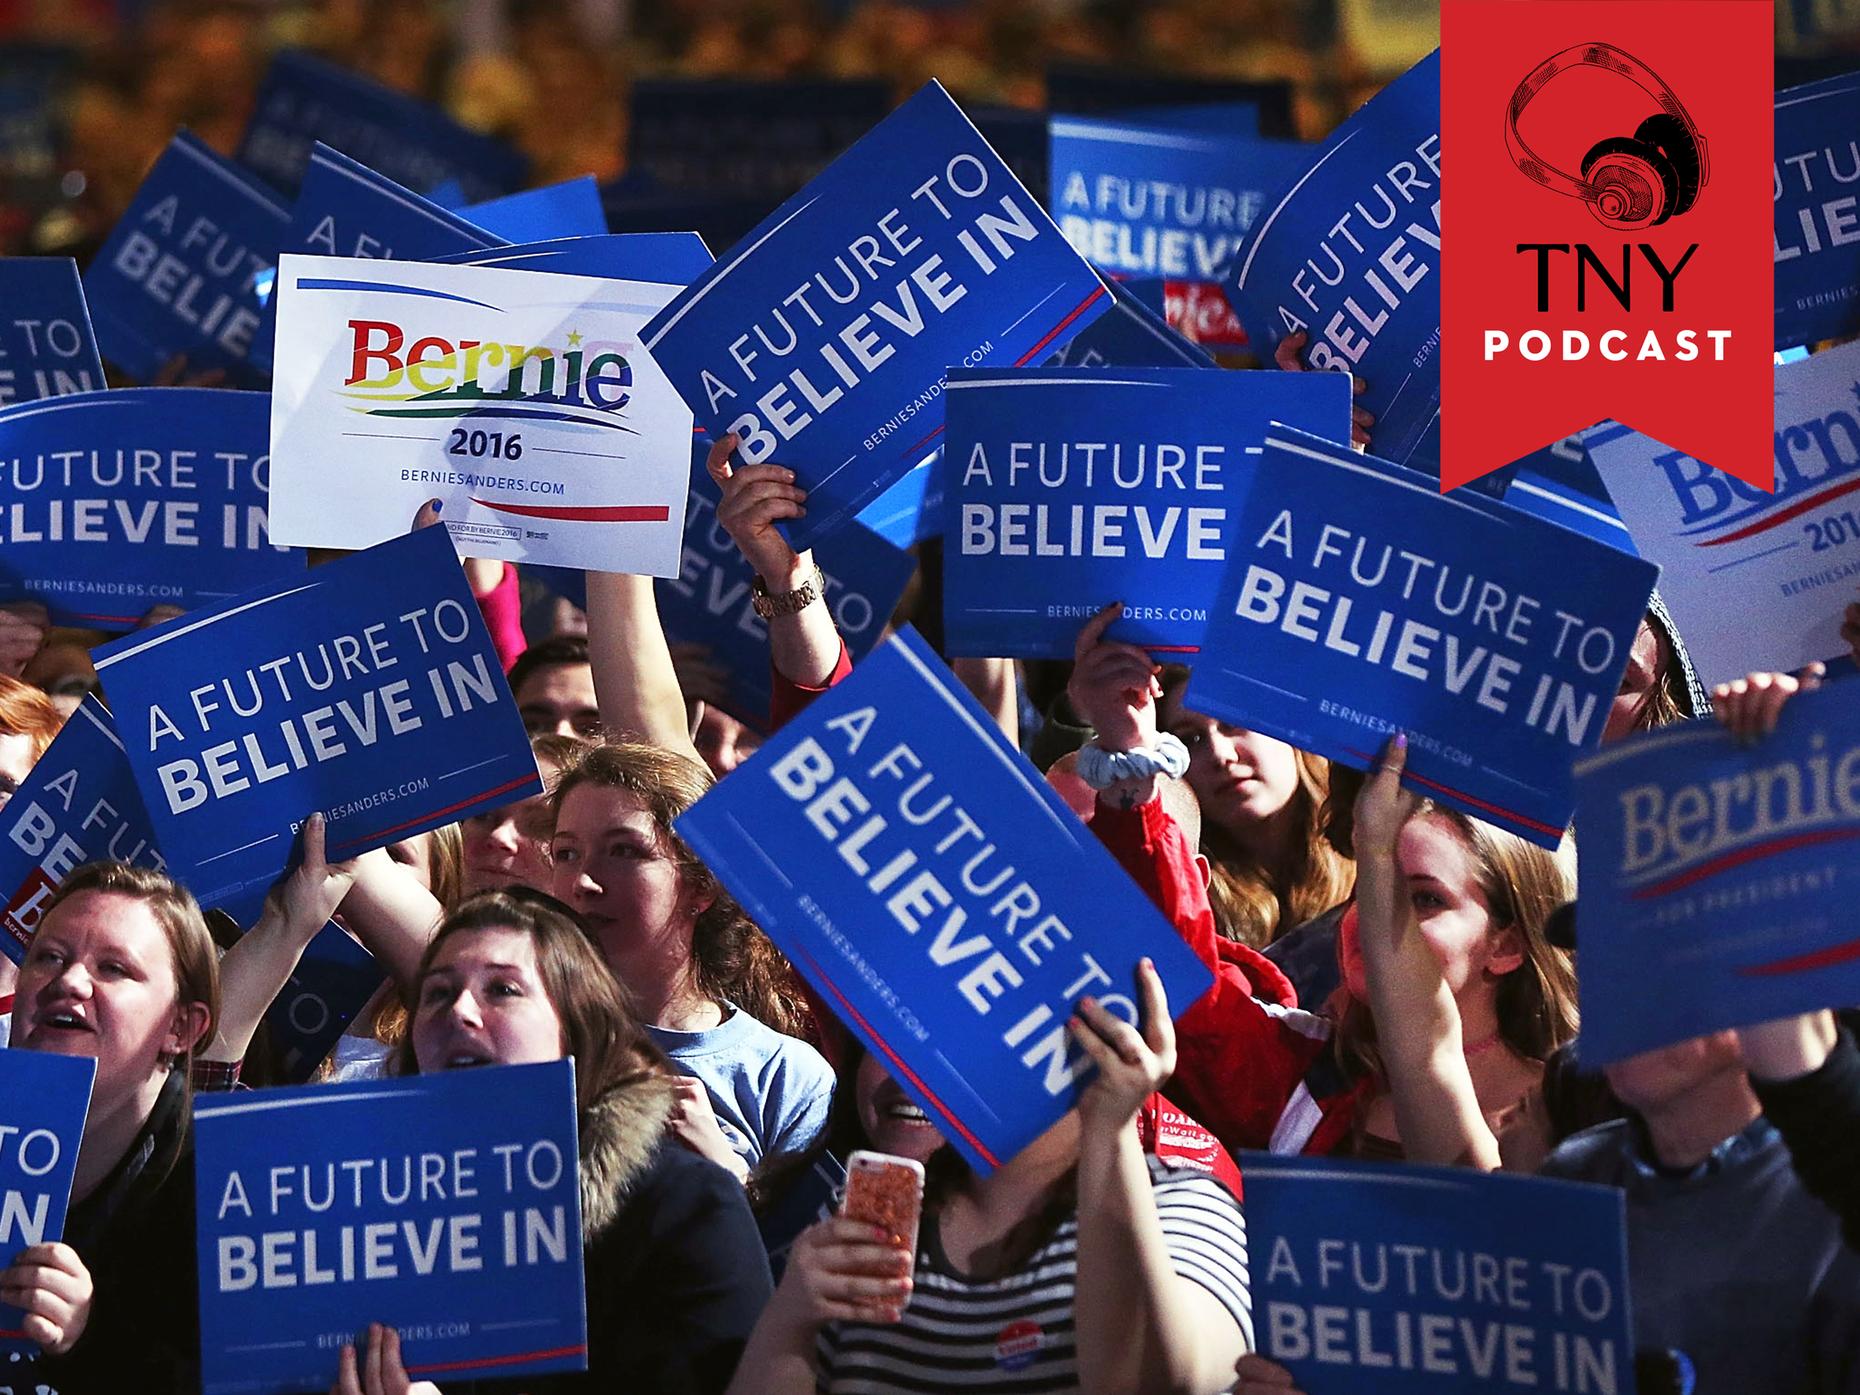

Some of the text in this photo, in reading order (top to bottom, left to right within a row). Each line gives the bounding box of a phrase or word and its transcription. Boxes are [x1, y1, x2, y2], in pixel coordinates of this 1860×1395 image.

[145, 195, 179, 236] A
[1062, 171, 1090, 212] A
[306, 214, 337, 250] A
[1059, 214, 1243, 281] BELIEV
[700, 153, 988, 415] A FUTURE TO
[13, 319, 82, 357] TO
[726, 195, 1040, 465] BELIEVE IN
[344, 319, 634, 411] Bernie
[864, 341, 994, 451] BERNIESANDECOM
[0, 450, 197, 490] UTURE
[449, 428, 523, 460] 2016
[963, 443, 1225, 491] A FUTURE
[401, 469, 565, 495] BERNIESANDERS.COM
[0, 499, 199, 546] LIEVE
[961, 504, 1226, 561] BELIEVE
[24, 579, 184, 597] BERNIESANDERS.COM
[1047, 604, 1207, 621] BERNIESDERS.COM
[1256, 509, 1615, 674] A FUTURE TO
[149, 599, 470, 751] A FUTURE TO
[1235, 565, 1599, 747] BELIEVE IN
[157, 653, 498, 815] BELIEVE IN
[1320, 699, 1473, 767] BERNIESADERS.COM
[43, 769, 79, 812] A
[290, 777, 430, 835] BENIESANDERS.COM
[824, 705, 878, 756] A
[869, 743, 1073, 967] FUTURE
[770, 735, 1024, 1015] BELIEVE
[1003, 1004, 1098, 1098] IN
[798, 895, 931, 1042] BERNIESANDERS.COM
[218, 1139, 563, 1220] A FUTURE TO
[218, 1205, 568, 1292] BELIEVE IN
[1266, 1236, 1611, 1322] A FUTURE TO
[318, 1322, 471, 1349] BERNDERS.COM
[1268, 1302, 1618, 1395] BELIEVE IN
